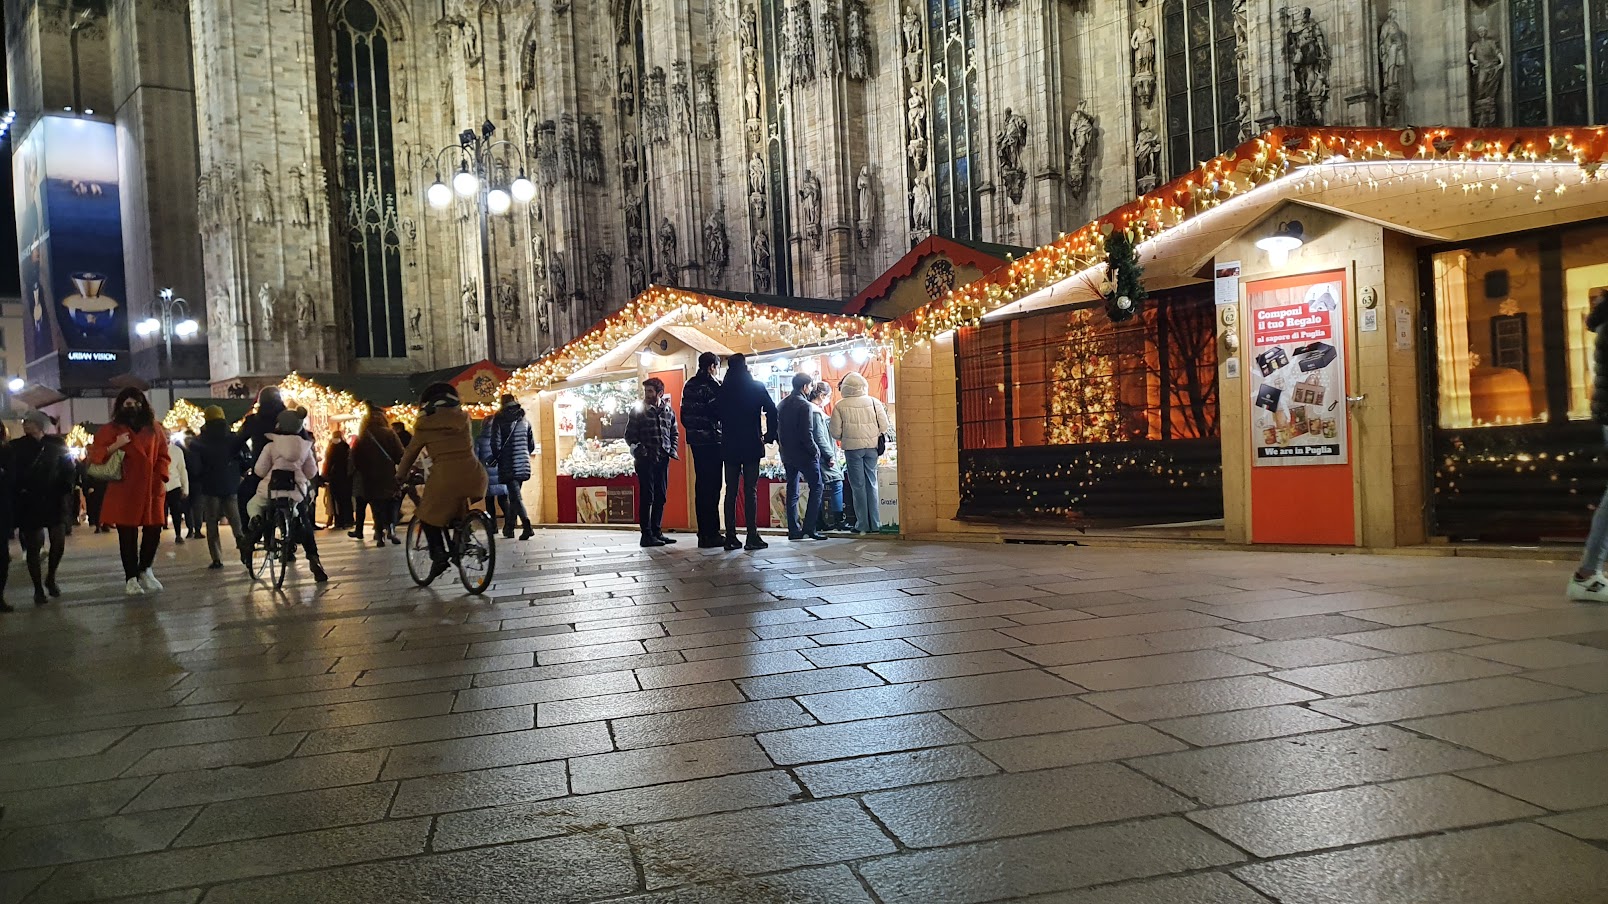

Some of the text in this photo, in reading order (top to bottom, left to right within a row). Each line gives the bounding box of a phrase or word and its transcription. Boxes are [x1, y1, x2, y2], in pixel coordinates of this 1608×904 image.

[1362, 295, 1373, 305] 63
[1225, 313, 1235, 322] 62
[1257, 306, 1303, 320] Componi
[1258, 315, 1322, 331] il tuo Regalo
[1265, 334, 1291, 343] sapore
[1291, 331, 1300, 339] di
[1300, 329, 1326, 339] Puglia
[68, 351, 117, 361] URBAN VISION
[1264, 448, 1279, 456] We
[1279, 447, 1294, 455] are
[1305, 445, 1333, 456] Puglia
[880, 498, 898, 506] Grazie!
